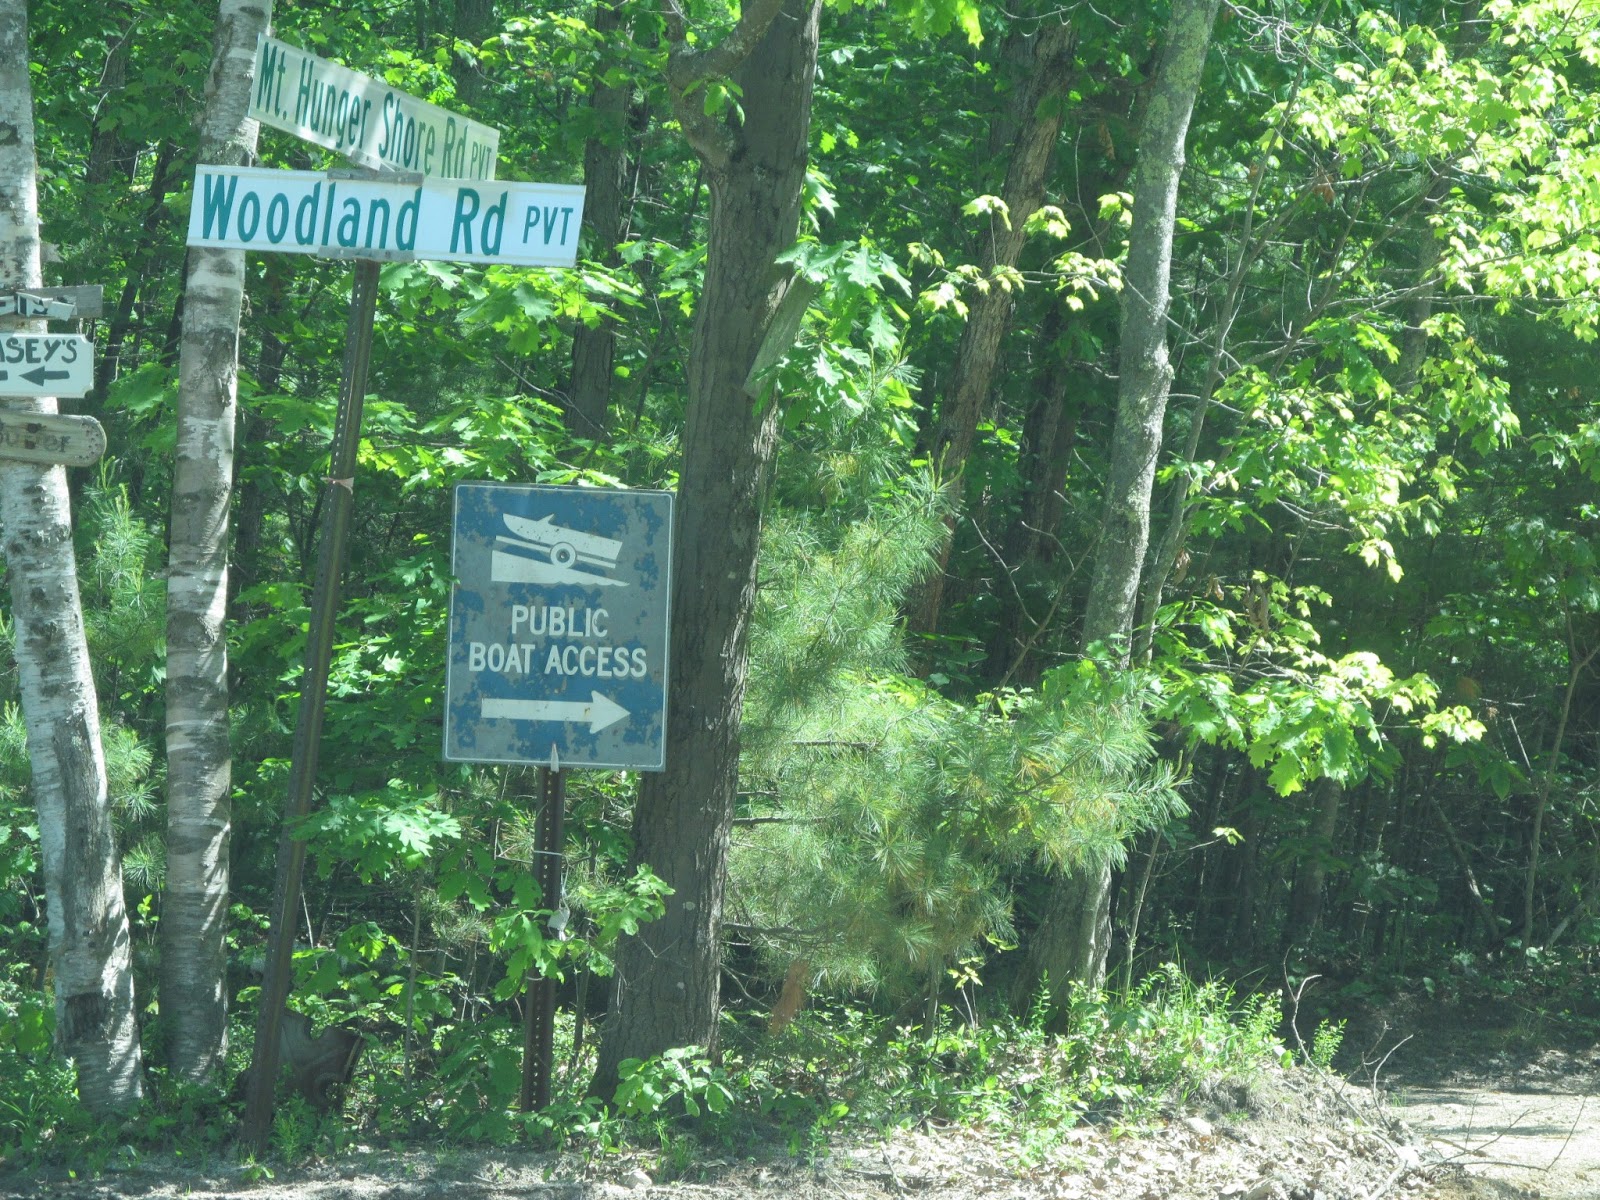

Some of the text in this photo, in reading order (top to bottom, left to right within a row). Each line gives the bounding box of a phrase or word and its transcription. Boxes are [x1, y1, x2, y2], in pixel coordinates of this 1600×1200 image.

[257, 42, 492, 179] Mt. Hunger Shore Rd PVT
[202, 174, 573, 256] Woodland Rd PVT
[512, 605, 609, 638] PUBLIC
[468, 642, 647, 678] BOAT ACCESS
